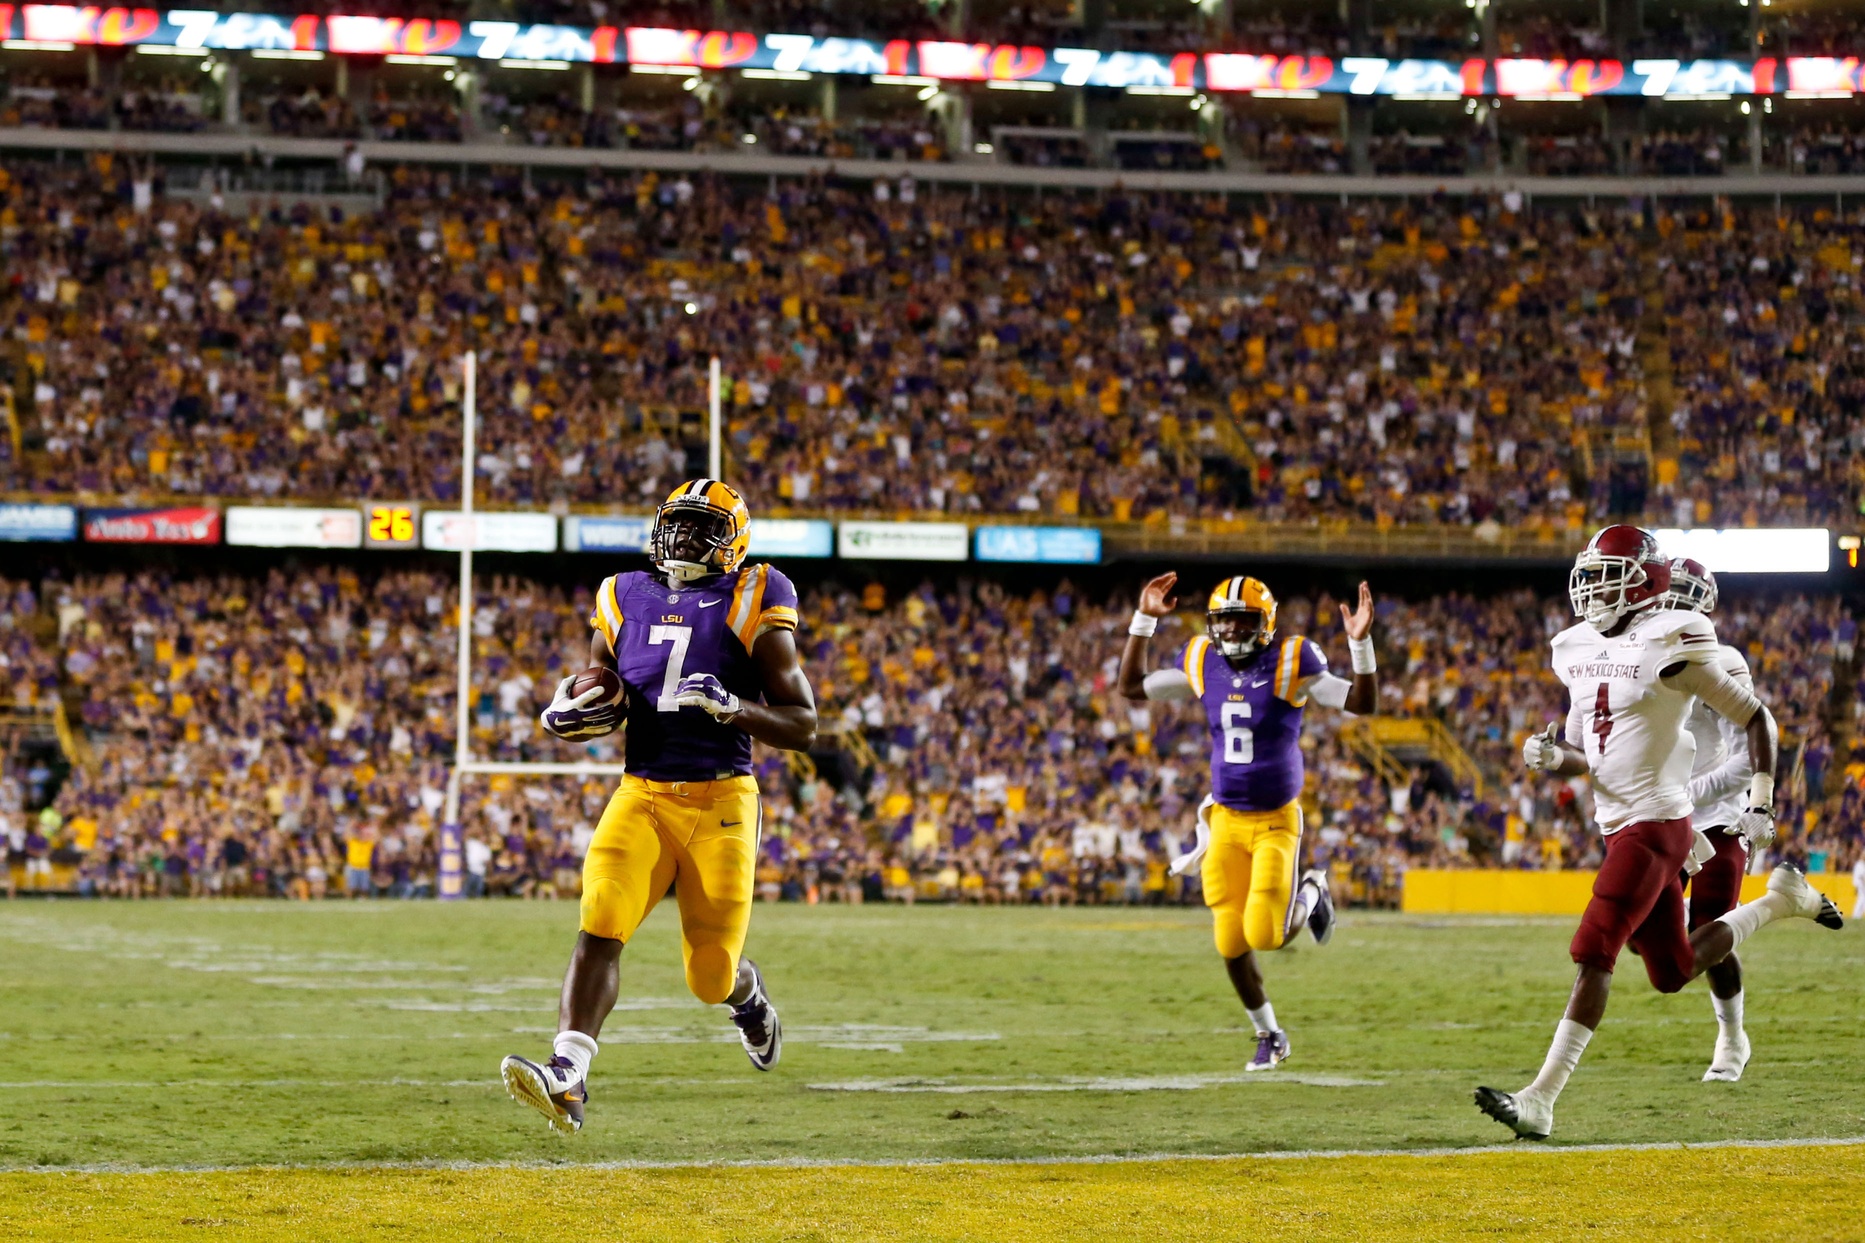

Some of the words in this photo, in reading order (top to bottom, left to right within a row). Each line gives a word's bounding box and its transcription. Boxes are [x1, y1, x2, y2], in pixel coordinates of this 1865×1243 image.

[369, 506, 414, 541] 26
[661, 615, 684, 624] LSU
[648, 625, 692, 711] 7
[1568, 665, 1583, 679] NEW
[1585, 664, 1614, 678] MEXICO
[1614, 665, 1640, 679] STATE
[1221, 702, 1254, 764] 6
[1592, 683, 1614, 754] 4
